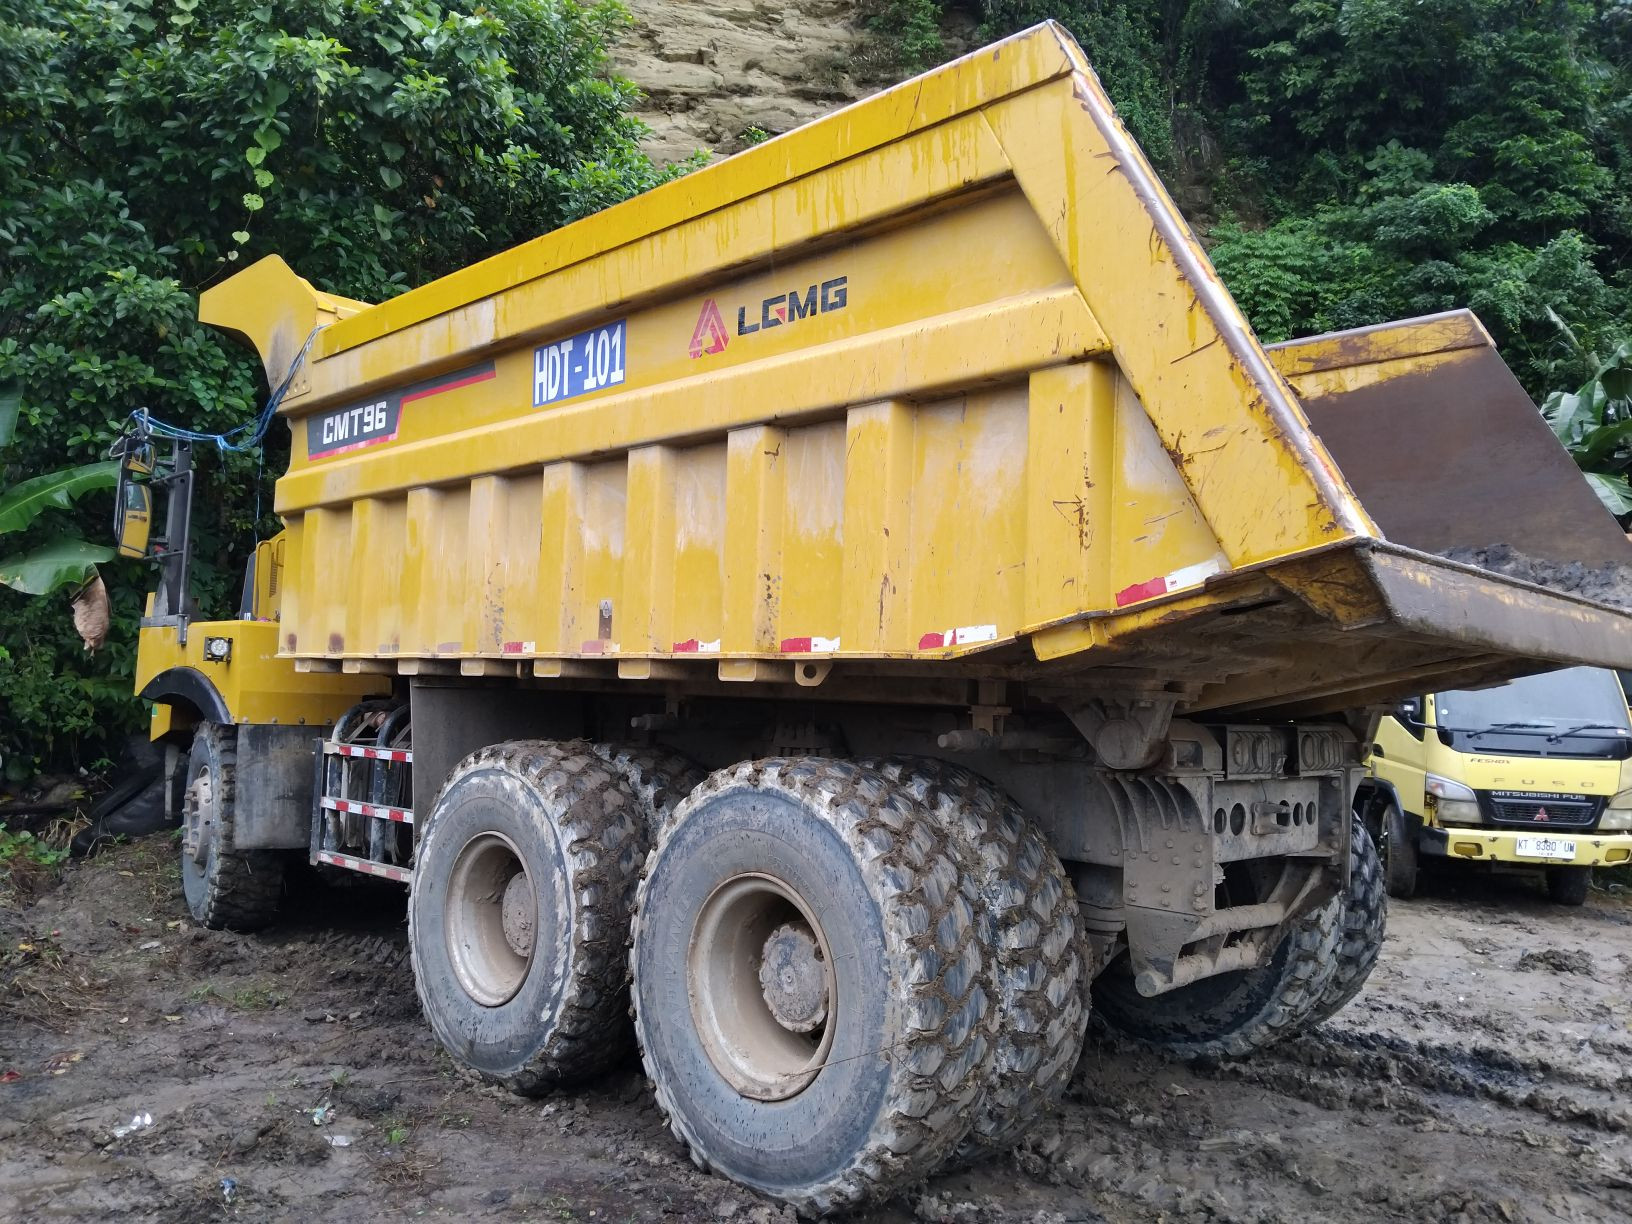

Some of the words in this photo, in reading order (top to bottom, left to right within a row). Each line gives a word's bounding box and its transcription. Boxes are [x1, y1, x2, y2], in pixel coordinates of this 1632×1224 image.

[323, 401, 387, 445] CMT96
[1491, 790, 1560, 799] MITSUBISHI
[1518, 840, 1528, 849] KT
